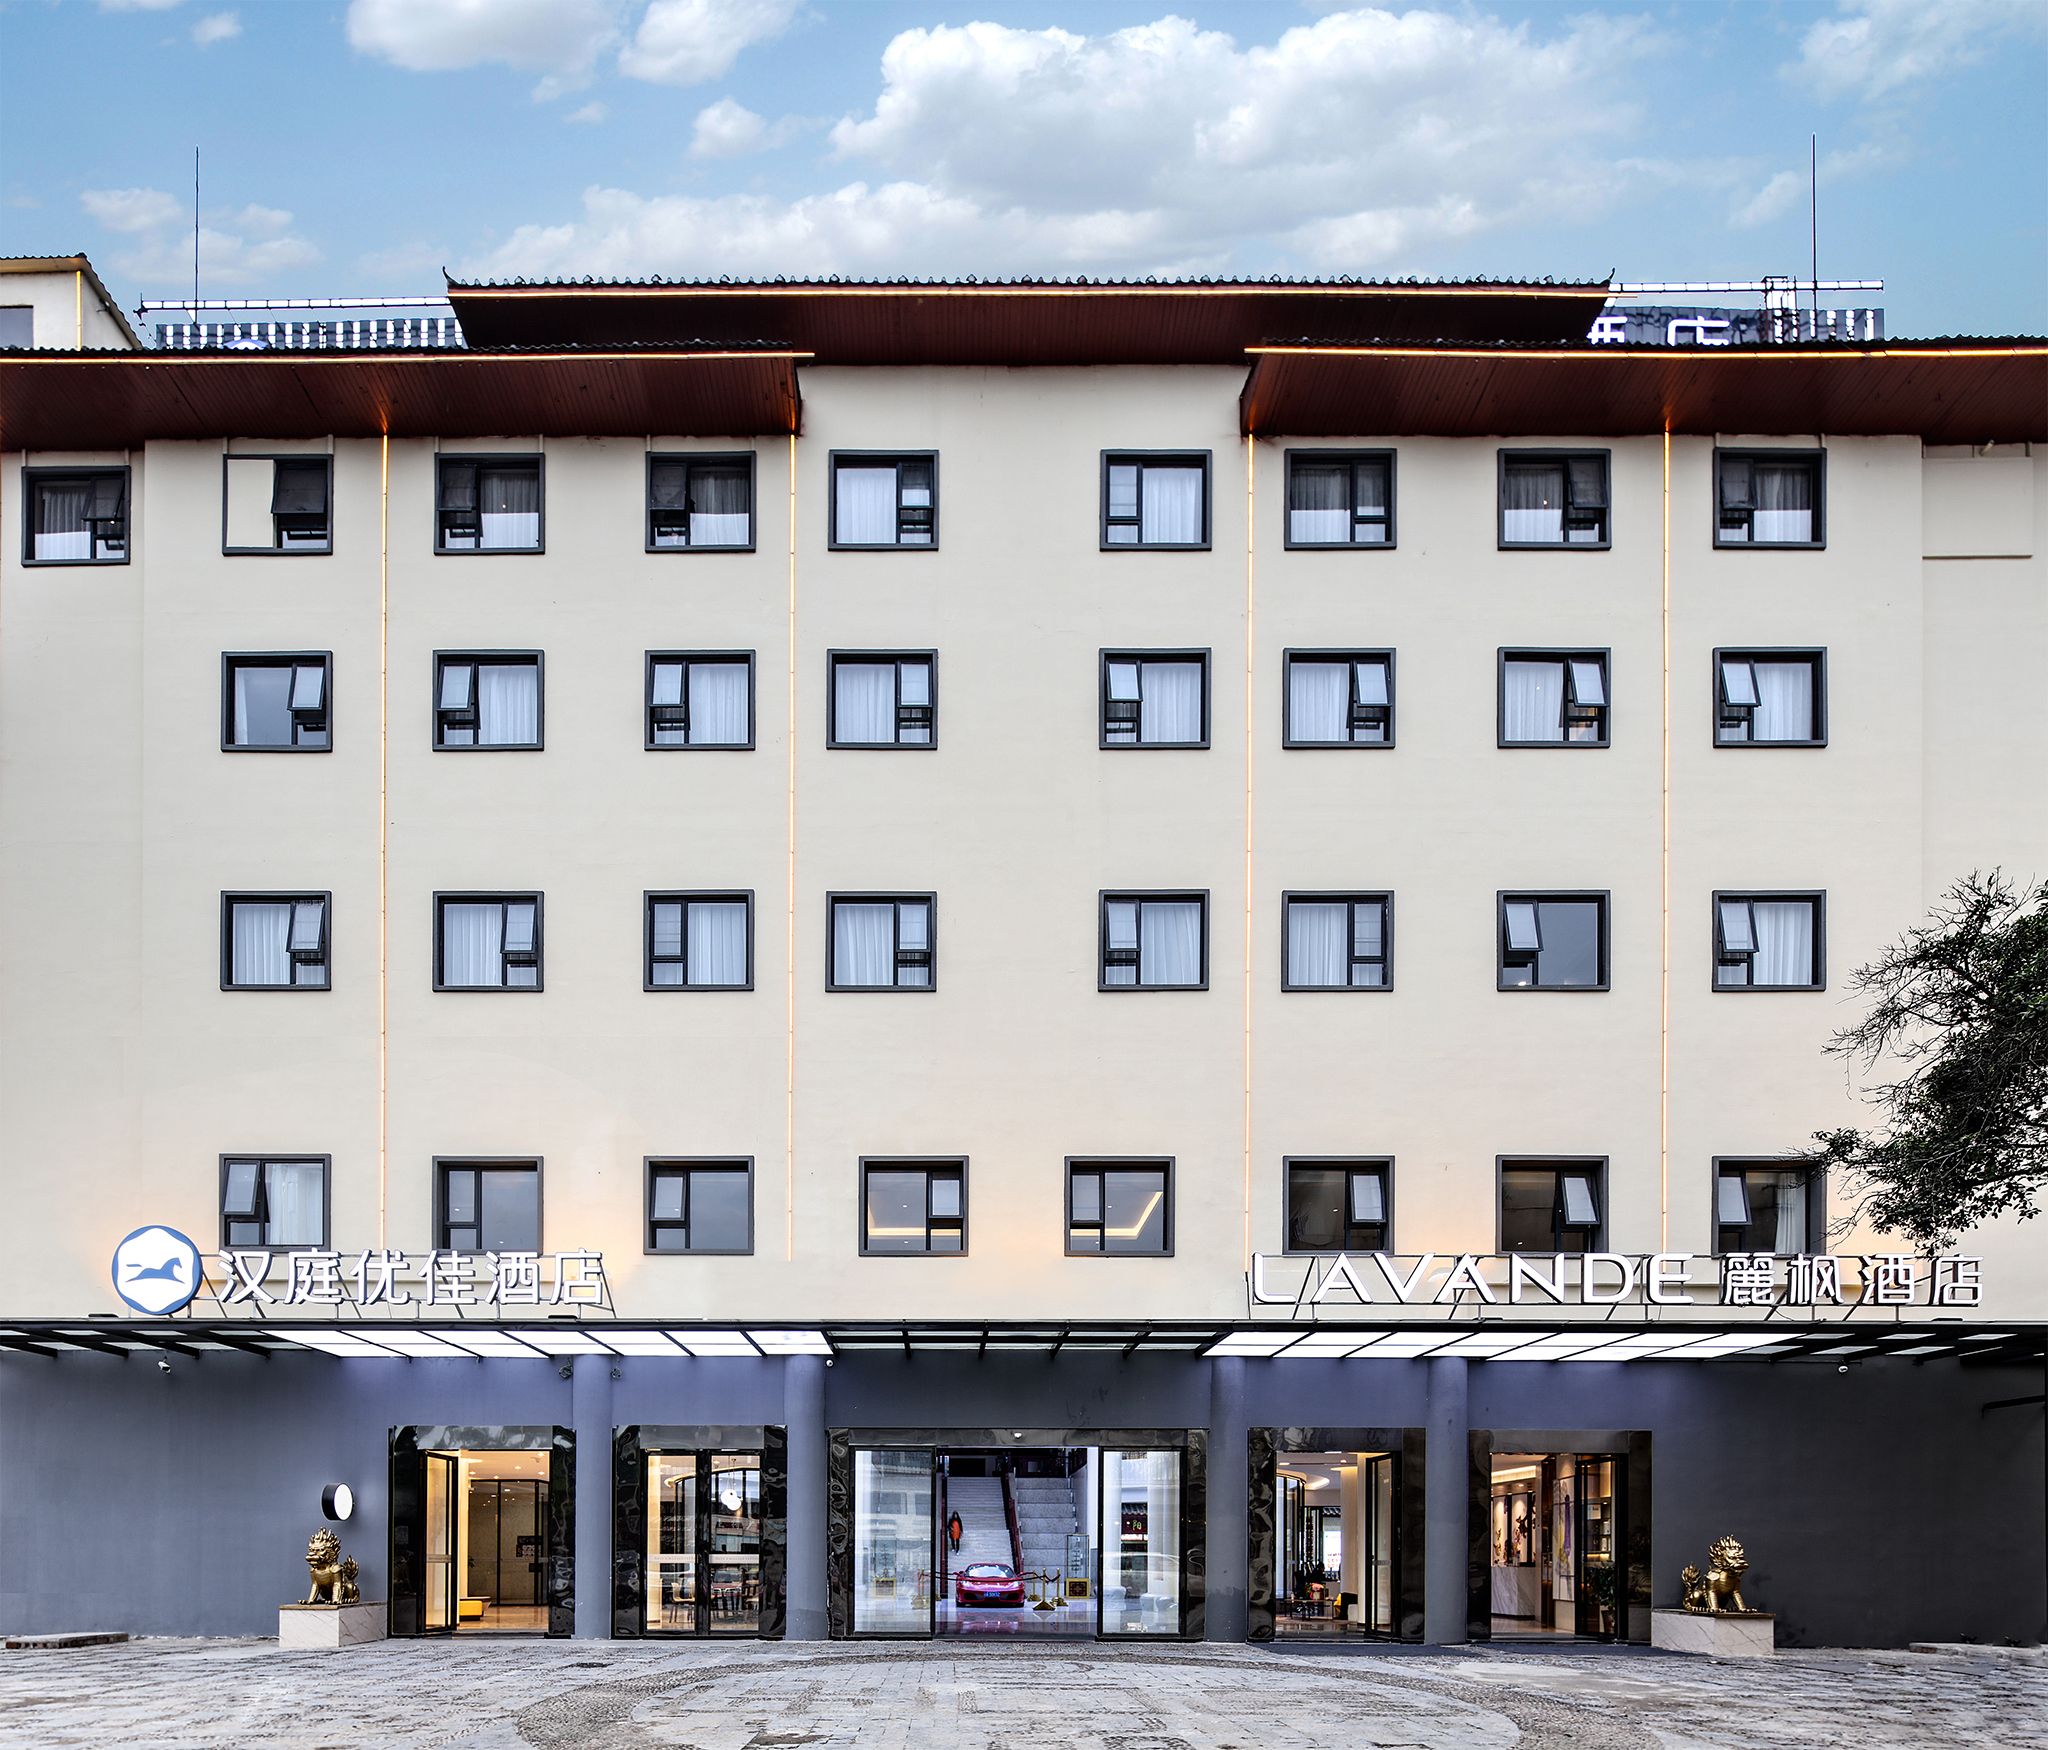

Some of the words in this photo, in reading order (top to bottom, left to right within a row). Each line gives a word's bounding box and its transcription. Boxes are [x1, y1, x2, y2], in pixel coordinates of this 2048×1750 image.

[218, 1247, 602, 1305] 汉庭优佳酒店
[1253, 1252, 1695, 1304] LAVANDE
[1722, 1252, 1984, 1304] 麗枫酒店
